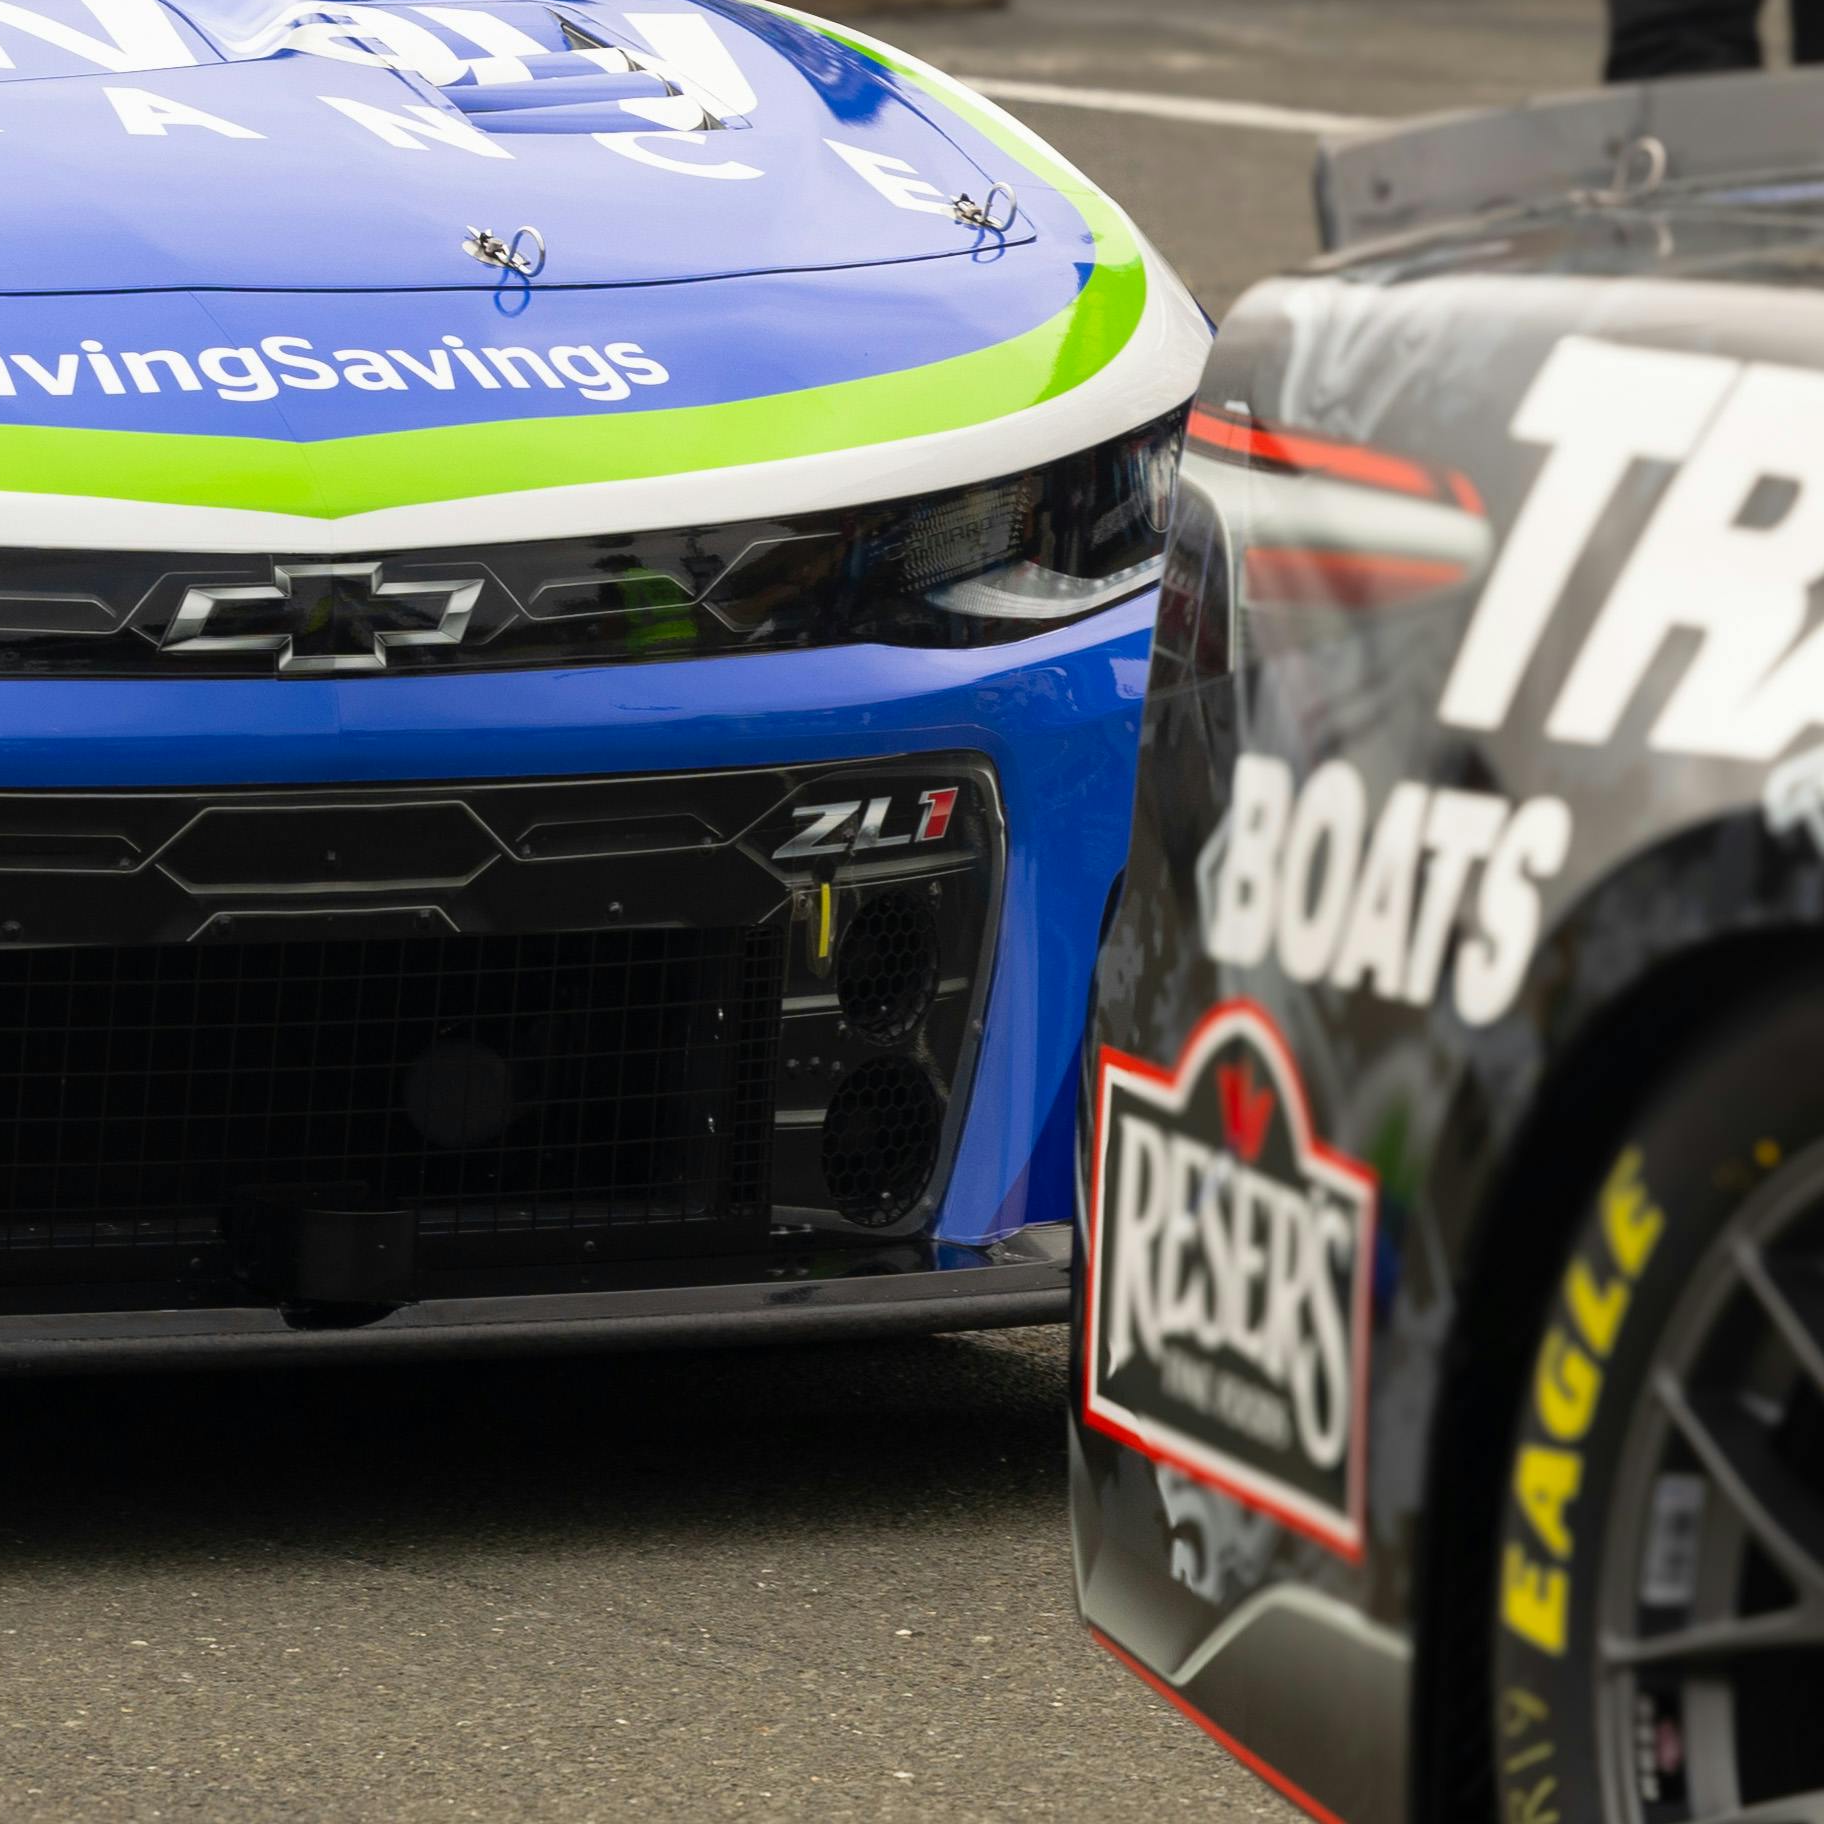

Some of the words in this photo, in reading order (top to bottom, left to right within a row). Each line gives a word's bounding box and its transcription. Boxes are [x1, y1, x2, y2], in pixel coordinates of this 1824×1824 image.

[771, 786, 959, 860] ZL1
[1205, 751, 1572, 1027] BOATS
[1500, 1144, 1664, 1658] EAGLE
